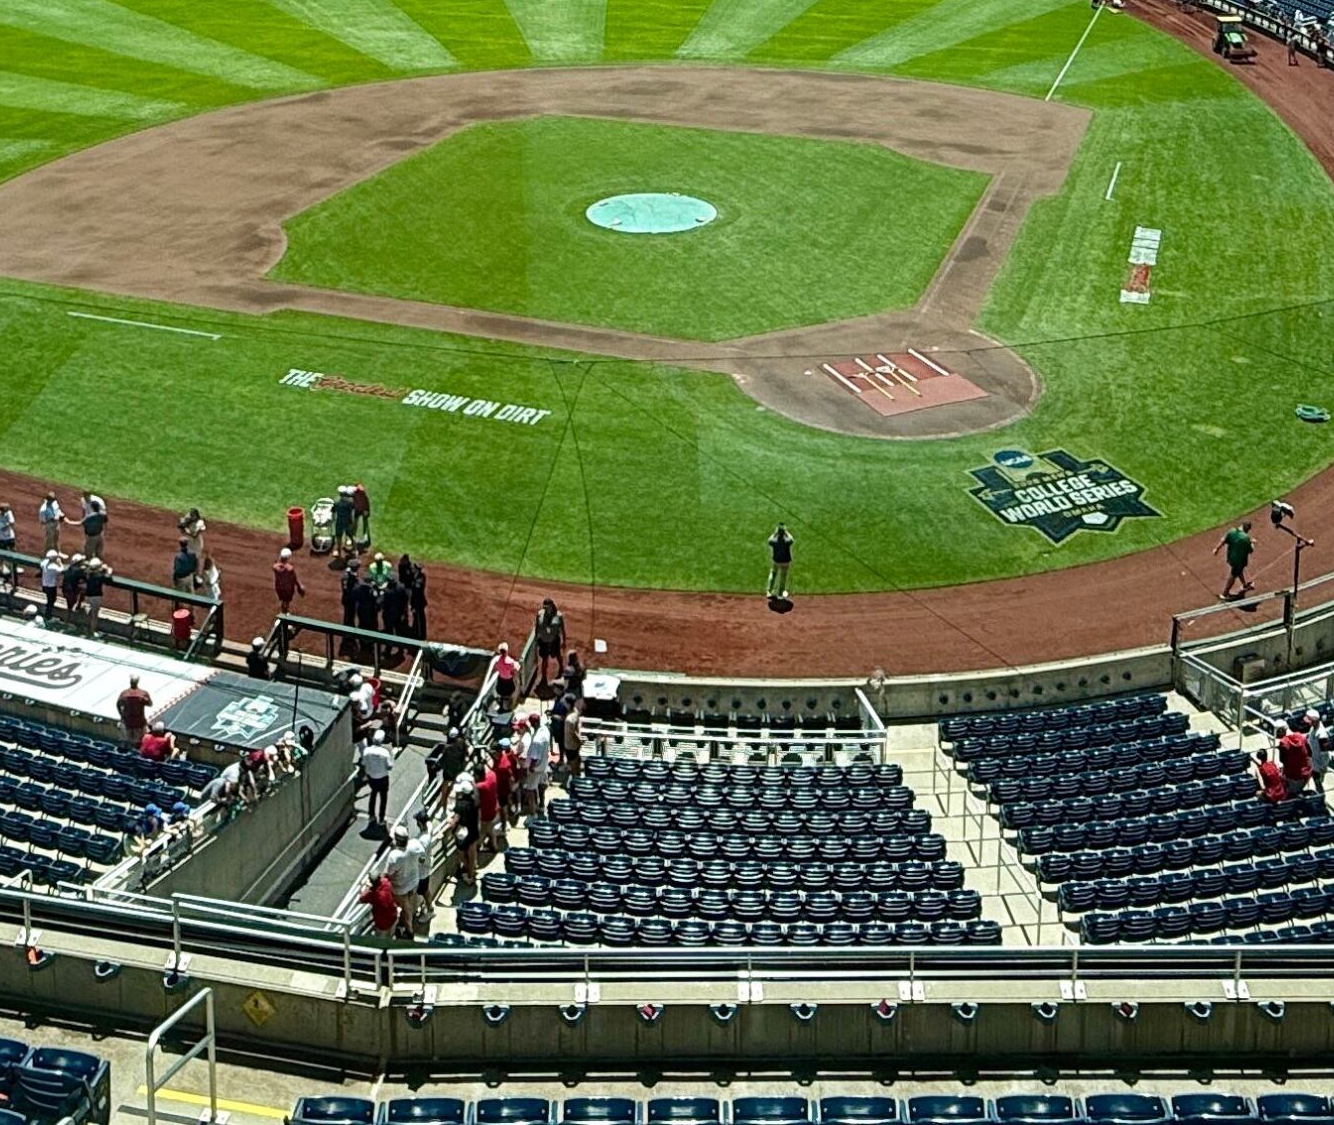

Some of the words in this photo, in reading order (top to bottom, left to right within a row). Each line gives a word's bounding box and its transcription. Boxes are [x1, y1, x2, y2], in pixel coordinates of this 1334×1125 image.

[279, 369, 324, 388] THE
[402, 389, 470, 412] SHOW
[463, 398, 500, 418] ON
[494, 404, 551, 425] DIRT
[999, 495, 1068, 523] WORLD
[1068, 479, 1138, 505] SERIES
[1014, 474, 1097, 503] COLLEGE
